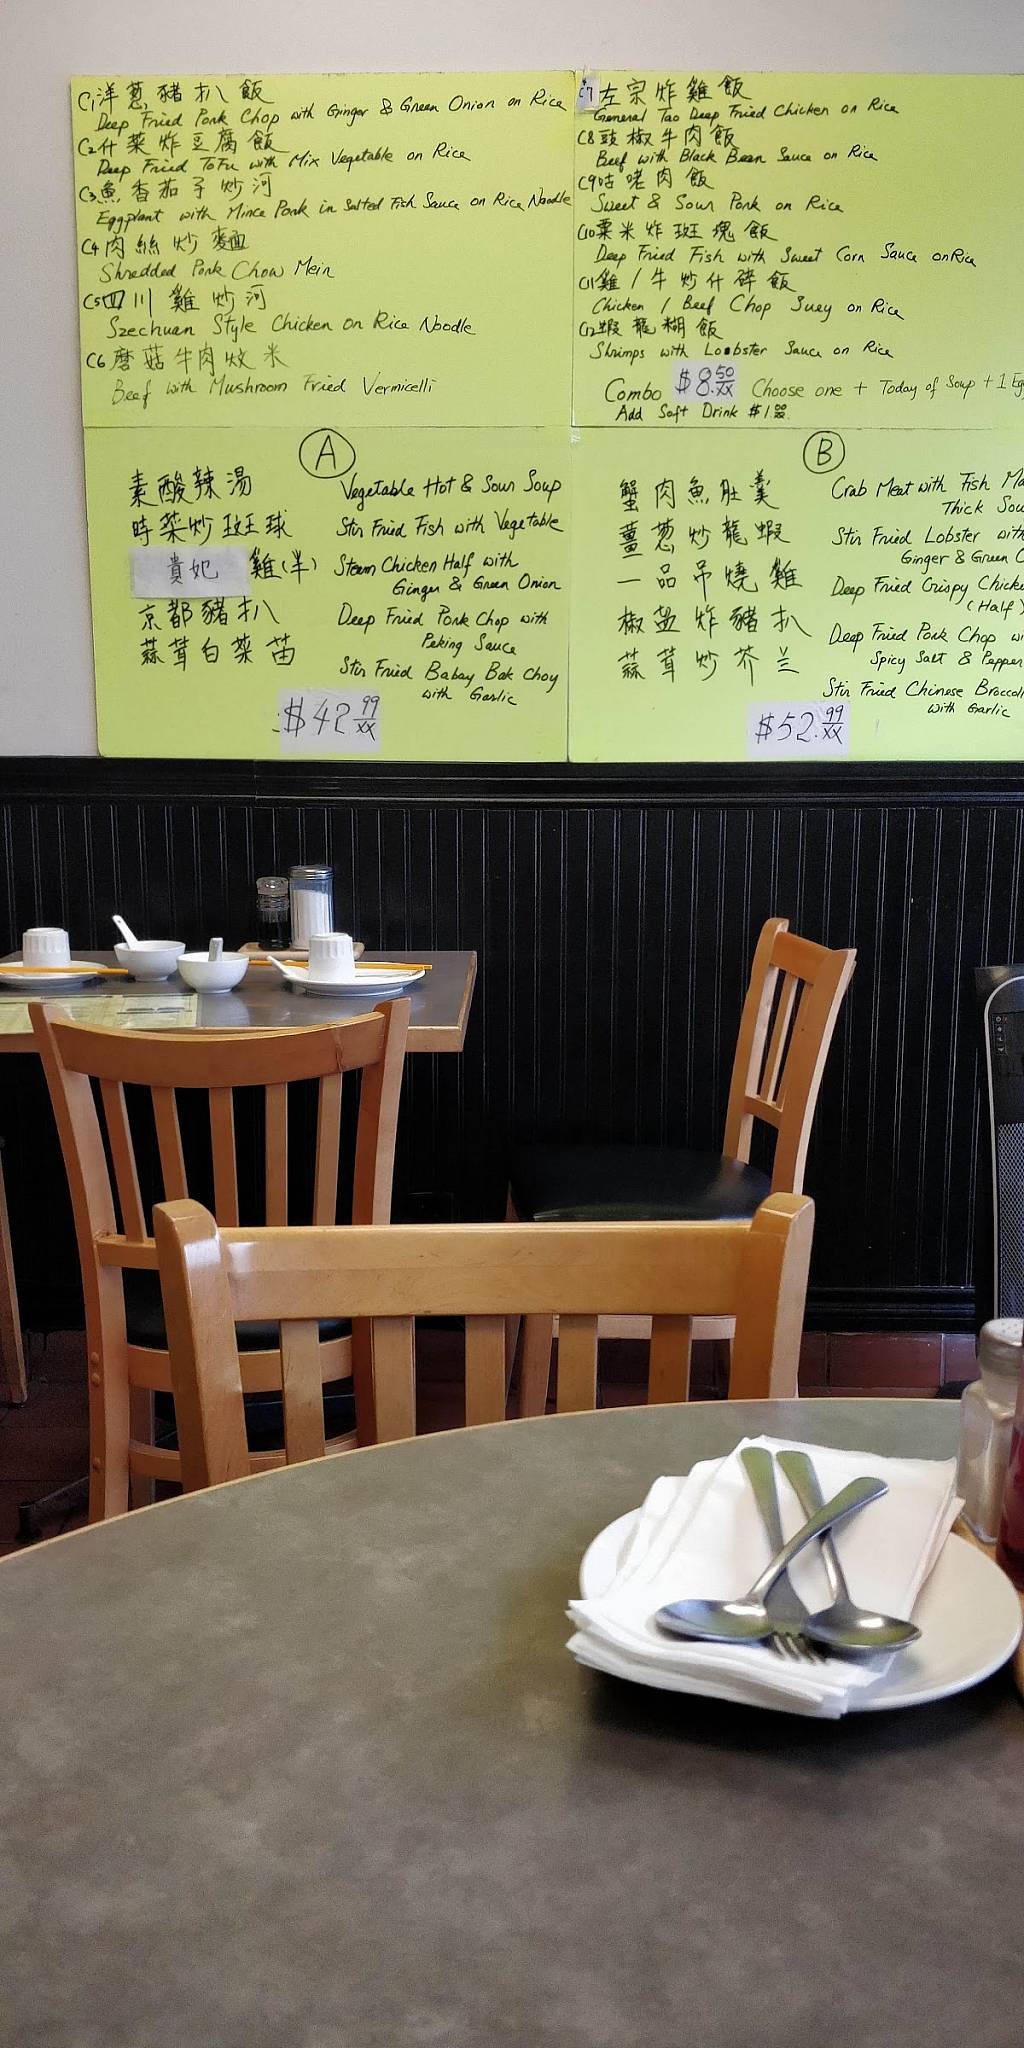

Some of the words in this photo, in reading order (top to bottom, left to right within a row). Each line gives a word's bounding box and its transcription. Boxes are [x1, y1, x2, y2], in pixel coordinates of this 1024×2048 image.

[94, 113, 129, 137] Deep
[141, 111, 183, 128] Fried
[194, 108, 229, 126] Pork
[240, 108, 280, 132] Chop
[290, 102, 314, 120] with
[326, 103, 368, 127] Ginger
[400, 96, 439, 113] Green
[449, 94, 495, 113] Onion
[530, 88, 568, 112] Rice
[593, 107, 648, 123] General
[657, 107, 680, 123] Tao
[689, 106, 720, 129] Deep
[728, 103, 765, 119] Fried
[773, 101, 829, 118] Chicken
[868, 97, 900, 114] Rice
[96, 159, 131, 182] Deep
[142, 158, 189, 174] Fried
[249, 156, 278, 170] with
[288, 150, 320, 168] Mix
[331, 148, 394, 172] Vegetable
[433, 142, 472, 161] Rice
[596, 150, 628, 173] Beef
[637, 149, 669, 164] with
[679, 149, 716, 163] Black
[725, 149, 767, 165] Bean
[777, 147, 812, 162] Sauce
[848, 144, 879, 161] Rice
[96, 208, 164, 235] Eggplant
[179, 205, 217, 221] with
[226, 203, 267, 220] Mince
[274, 199, 310, 219] Pork
[344, 197, 384, 213] Salted
[390, 196, 417, 209] Fish
[422, 192, 460, 211] Sauce
[493, 191, 525, 212] Rice
[527, 187, 574, 207] Noodle
[590, 192, 640, 213] Sweet
[675, 194, 715, 212] Sour
[729, 191, 761, 211] Pork
[805, 195, 844, 213] Rice
[99, 261, 177, 283] Shredded
[191, 258, 228, 277] Pork
[231, 260, 284, 280] Chow
[294, 255, 335, 278] Mein
[594, 244, 627, 268] Deep
[638, 244, 676, 262] Fried
[689, 245, 725, 264] Fish
[737, 247, 766, 263] with
[781, 246, 824, 264] Sweet
[836, 246, 865, 263] Corn
[880, 242, 918, 263] Sauce
[591, 297, 644, 315] Chicken
[682, 294, 716, 315] Beef
[729, 294, 772, 320] Chop
[791, 295, 833, 323] Suey
[871, 298, 905, 320] Rice
[106, 315, 195, 339] Szechuan
[212, 314, 257, 343] Style
[271, 312, 333, 332] Chicken
[372, 309, 410, 330] Rice
[419, 315, 477, 335] Noodle
[590, 341, 645, 366] Shrimps
[660, 344, 689, 358] with
[784, 340, 822, 358] Sauce
[863, 340, 893, 358] Rice
[111, 378, 152, 409] Beef
[166, 377, 198, 394] with
[209, 374, 288, 394] Mushroom
[303, 373, 347, 393] Fried
[363, 371, 438, 396] Vermicelli
[605, 377, 662, 403] Combo
[752, 378, 804, 398] Choose
[815, 384, 843, 397] one
[880, 379, 917, 401] Today
[925, 377, 939, 400] of
[946, 374, 976, 399] Soup
[615, 405, 643, 421] Add
[658, 404, 689, 424] Soft
[701, 402, 738, 418] Drink
[340, 472, 416, 511] Vegetable
[423, 475, 456, 498] Hot
[481, 474, 516, 493] Sour
[523, 469, 562, 503] Soup
[831, 475, 868, 500] Crab
[876, 477, 914, 498] Meat
[918, 474, 947, 493] with
[960, 472, 991, 492] Fish
[942, 499, 984, 516] Thick
[336, 516, 364, 538] Stir
[371, 518, 407, 538] Fried
[415, 514, 444, 537] Fish
[454, 513, 485, 534] with
[494, 507, 564, 540] Vegetable
[831, 527, 862, 546] Stir
[872, 526, 912, 546] Fried
[924, 526, 981, 544] Lobster
[334, 553, 376, 577] Steam
[381, 555, 437, 573] Chicken
[443, 552, 475, 579] Half
[483, 551, 519, 568] with
[901, 549, 950, 575] Ginger
[971, 550, 1009, 563] Green
[392, 578, 440, 602] Ginger
[473, 575, 509, 591] Green
[518, 573, 562, 590] Onion
[830, 575, 866, 605] Deep
[874, 576, 913, 594] Fried
[921, 576, 969, 605] Crispy
[337, 602, 376, 634] Deep
[386, 607, 424, 626] Fried
[437, 604, 470, 627] Pork
[476, 608, 510, 634] Chop
[520, 610, 548, 625] with
[421, 632, 464, 658] Peking
[473, 633, 517, 656] Sauce
[828, 622, 864, 653] Deep
[872, 622, 908, 642] Fried
[916, 622, 949, 643] Pork
[957, 625, 997, 651] Chop
[339, 656, 366, 677] Stir
[375, 658, 414, 680] Fried
[523, 666, 559, 693] Choy
[870, 650, 906, 675] Spicy
[915, 650, 947, 665] Salt
[981, 650, 1024, 672] Pepper
[422, 687, 453, 700] with
[469, 687, 518, 706] Garlic
[822, 677, 850, 698] Stir
[860, 681, 897, 699] Fried
[905, 679, 964, 697] Chinese
[927, 702, 955, 715] with
[968, 703, 1011, 718] Garlic
